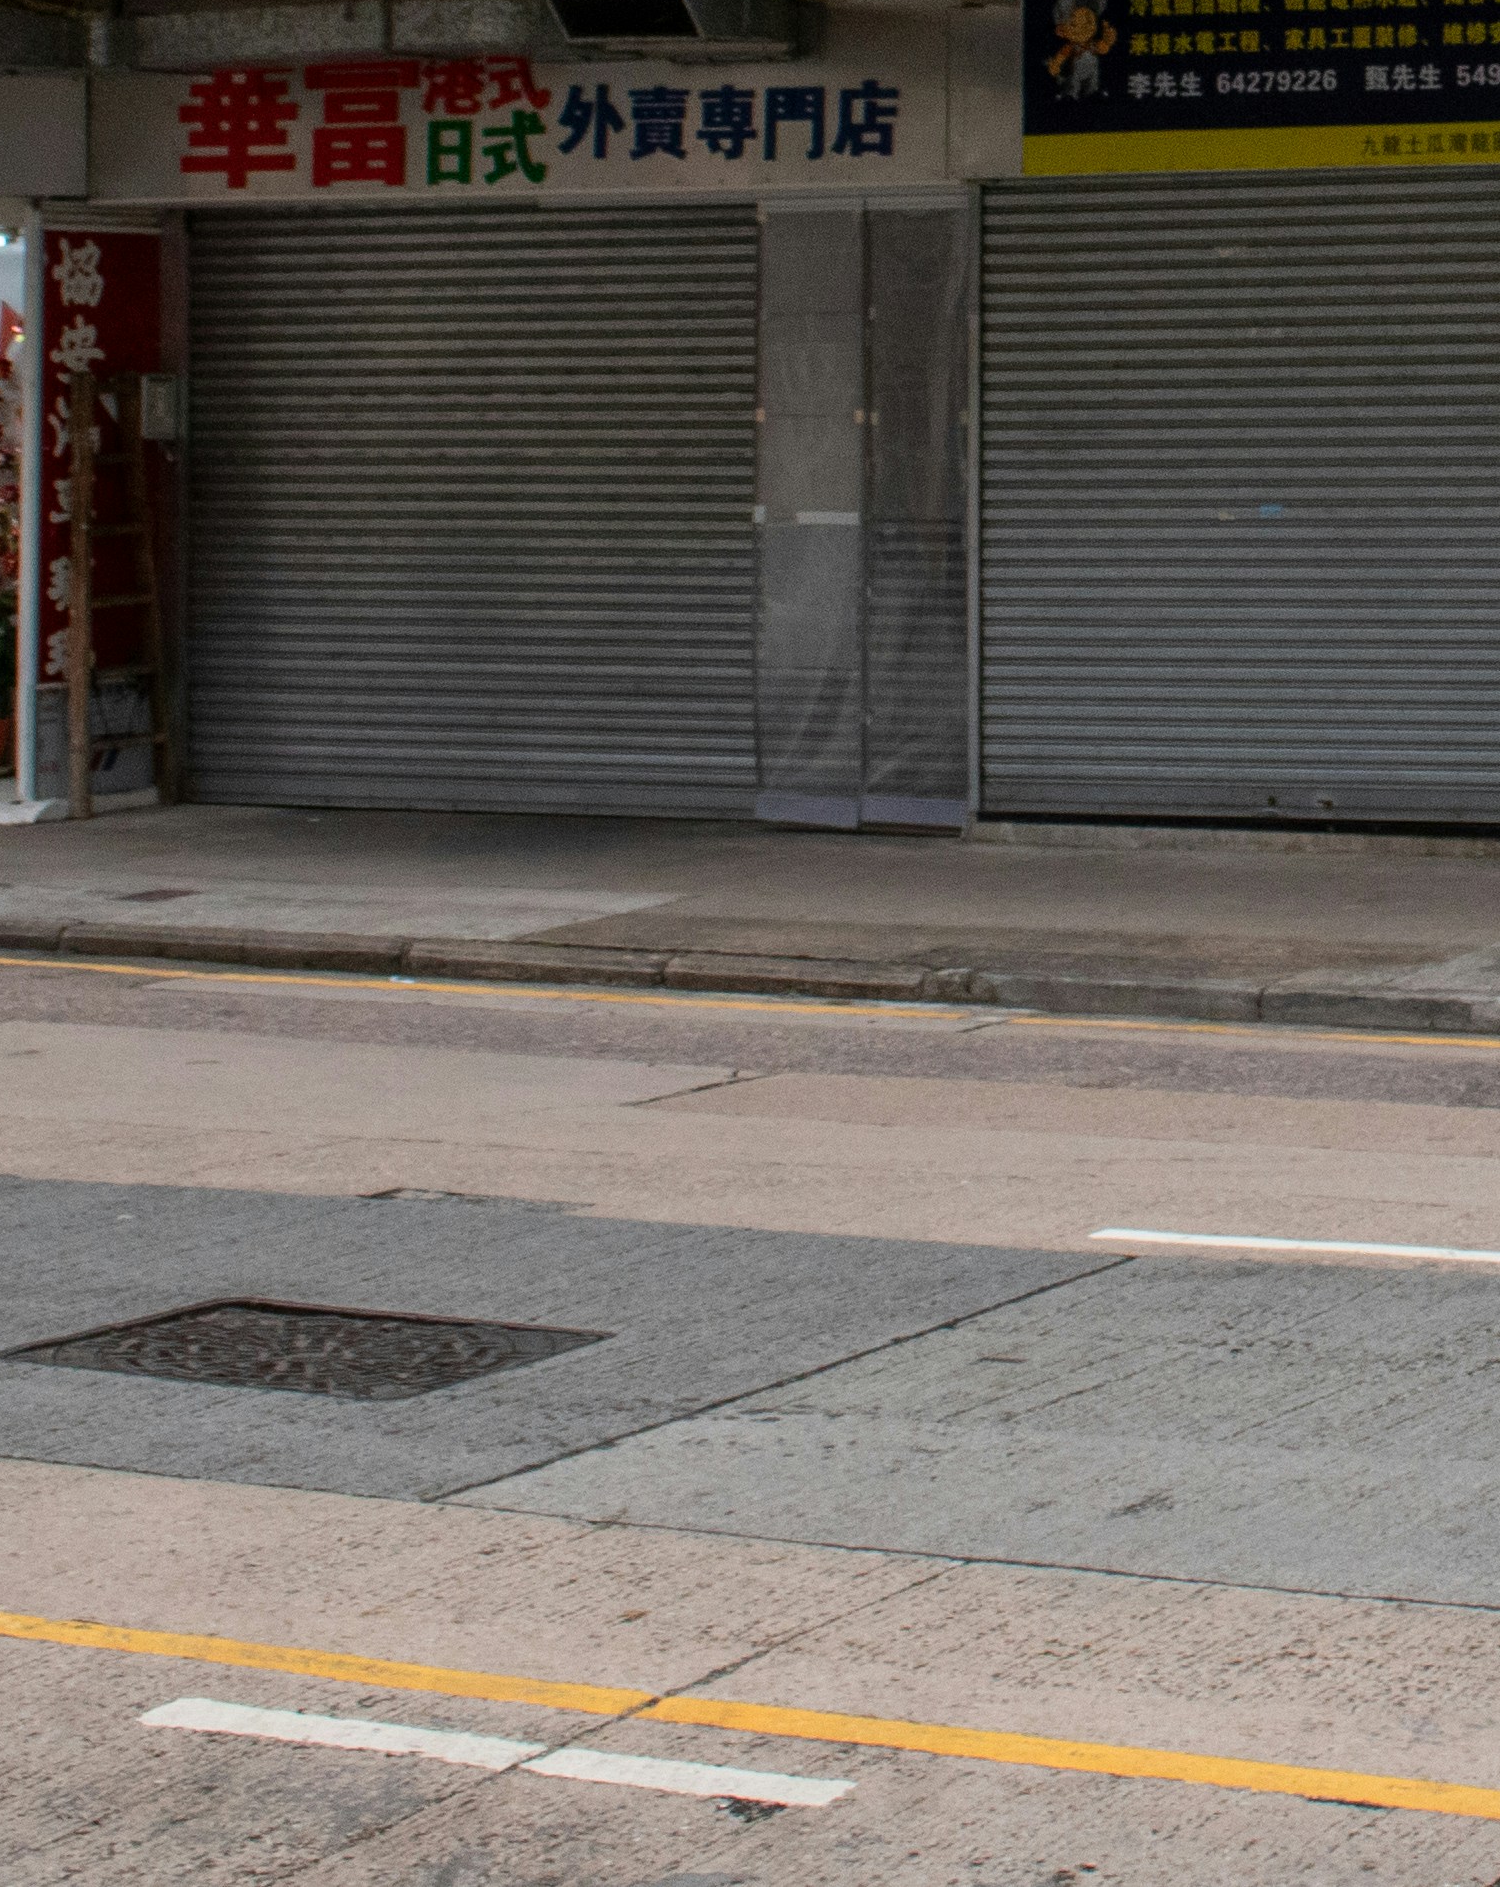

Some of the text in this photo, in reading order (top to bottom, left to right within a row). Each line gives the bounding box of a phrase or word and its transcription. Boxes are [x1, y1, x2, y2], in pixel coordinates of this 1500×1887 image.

[1128, 71, 1203, 98] 李先生
[1216, 69, 1338, 94] 64279226
[179, 58, 420, 189] 華富
[427, 110, 549, 185] 日式
